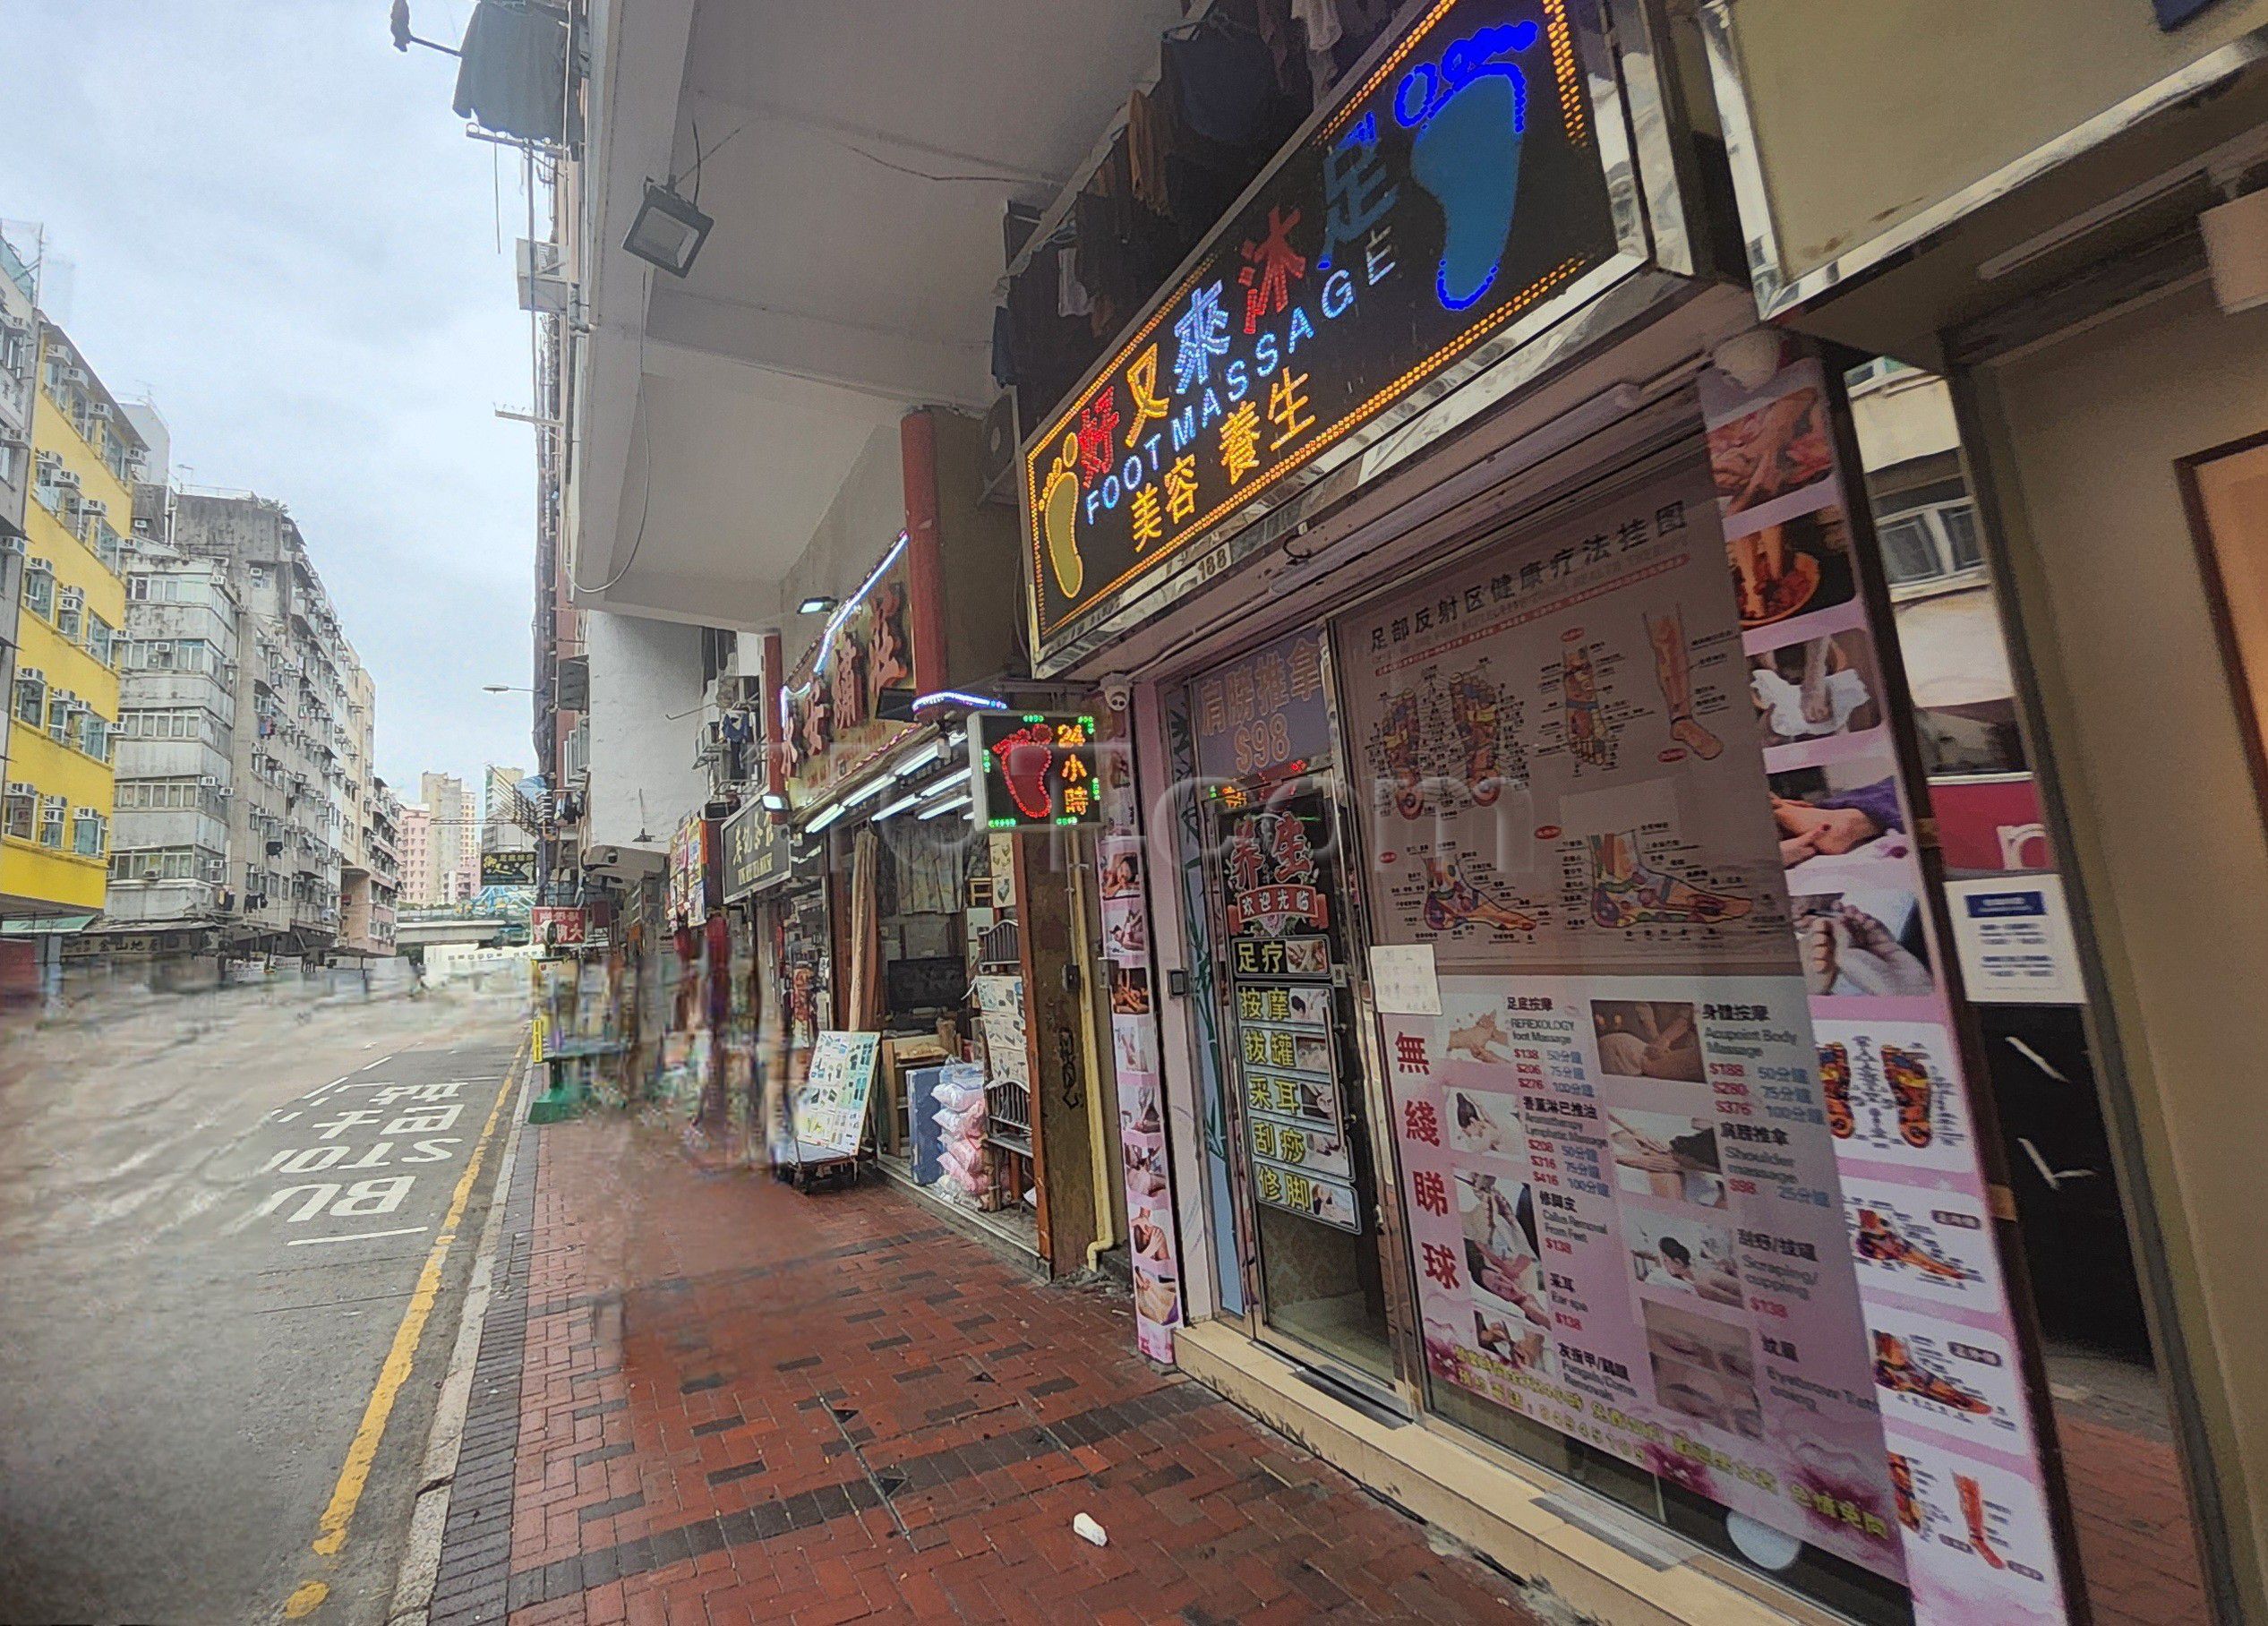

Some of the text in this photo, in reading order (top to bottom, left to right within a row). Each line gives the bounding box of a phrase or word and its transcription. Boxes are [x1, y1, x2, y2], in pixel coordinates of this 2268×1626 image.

[1087, 226, 1396, 526] FOOT MASSAGE
[1132, 366, 1316, 552] 美容 養生
[1371, 500, 1688, 653] 足部反射区健康疗法挂图
[1235, 714, 1290, 773] $98
[1232, 811, 1314, 890] 养生
[1242, 890, 1310, 918] 欢迎光临
[1237, 940, 1286, 974] 足疗
[1240, 988, 1291, 1021] 按摩
[1245, 1030, 1297, 1068] 拔罐
[1249, 1076, 1299, 1116] 采耳
[312, 1103, 466, 1141] 巴士
[1254, 1121, 1306, 1163] 刮痧
[1394, 1031, 1461, 1291] 無綫睇球
[253, 1176, 417, 1223] BU
[1258, 1167, 1311, 1212] 修脚
